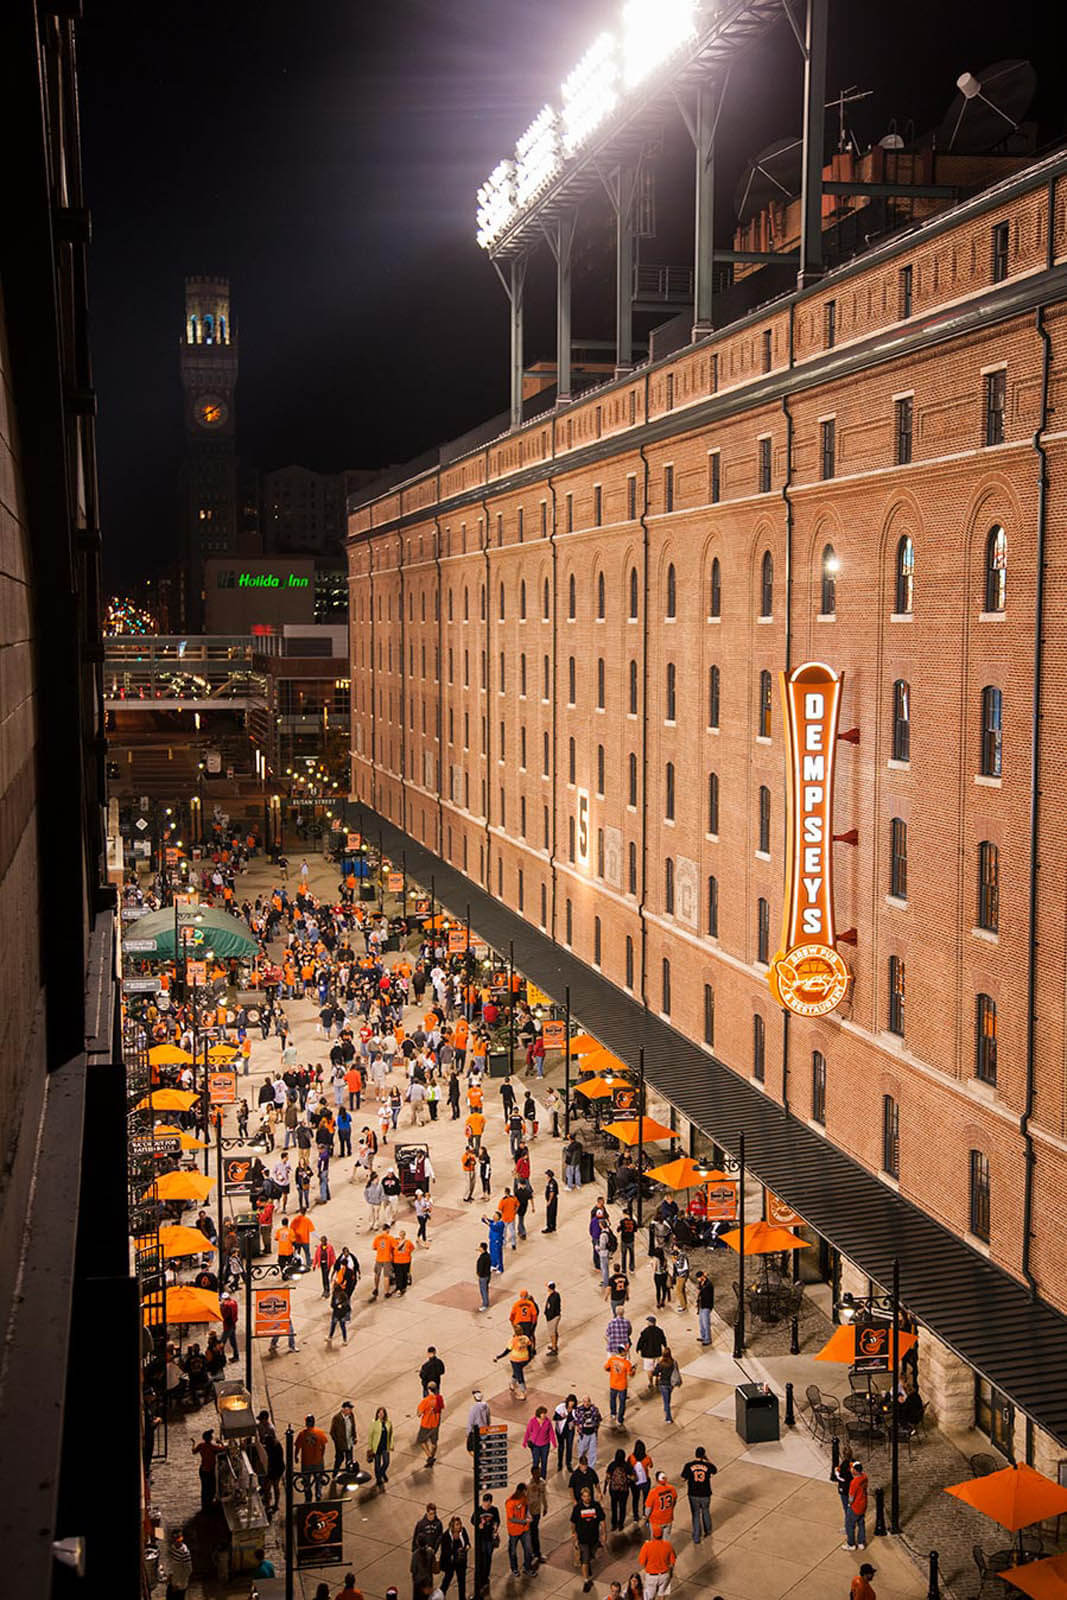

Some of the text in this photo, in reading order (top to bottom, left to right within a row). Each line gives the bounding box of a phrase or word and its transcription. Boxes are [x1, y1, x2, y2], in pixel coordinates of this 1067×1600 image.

[288, 574, 310, 588] Inn
[802, 692, 826, 935] DEMPSEYS
[578, 793, 589, 860] 5
[790, 946, 839, 965] BREW PUB
[791, 985, 845, 1015] RESTAURANT
[659, 1495, 673, 1511] 13
